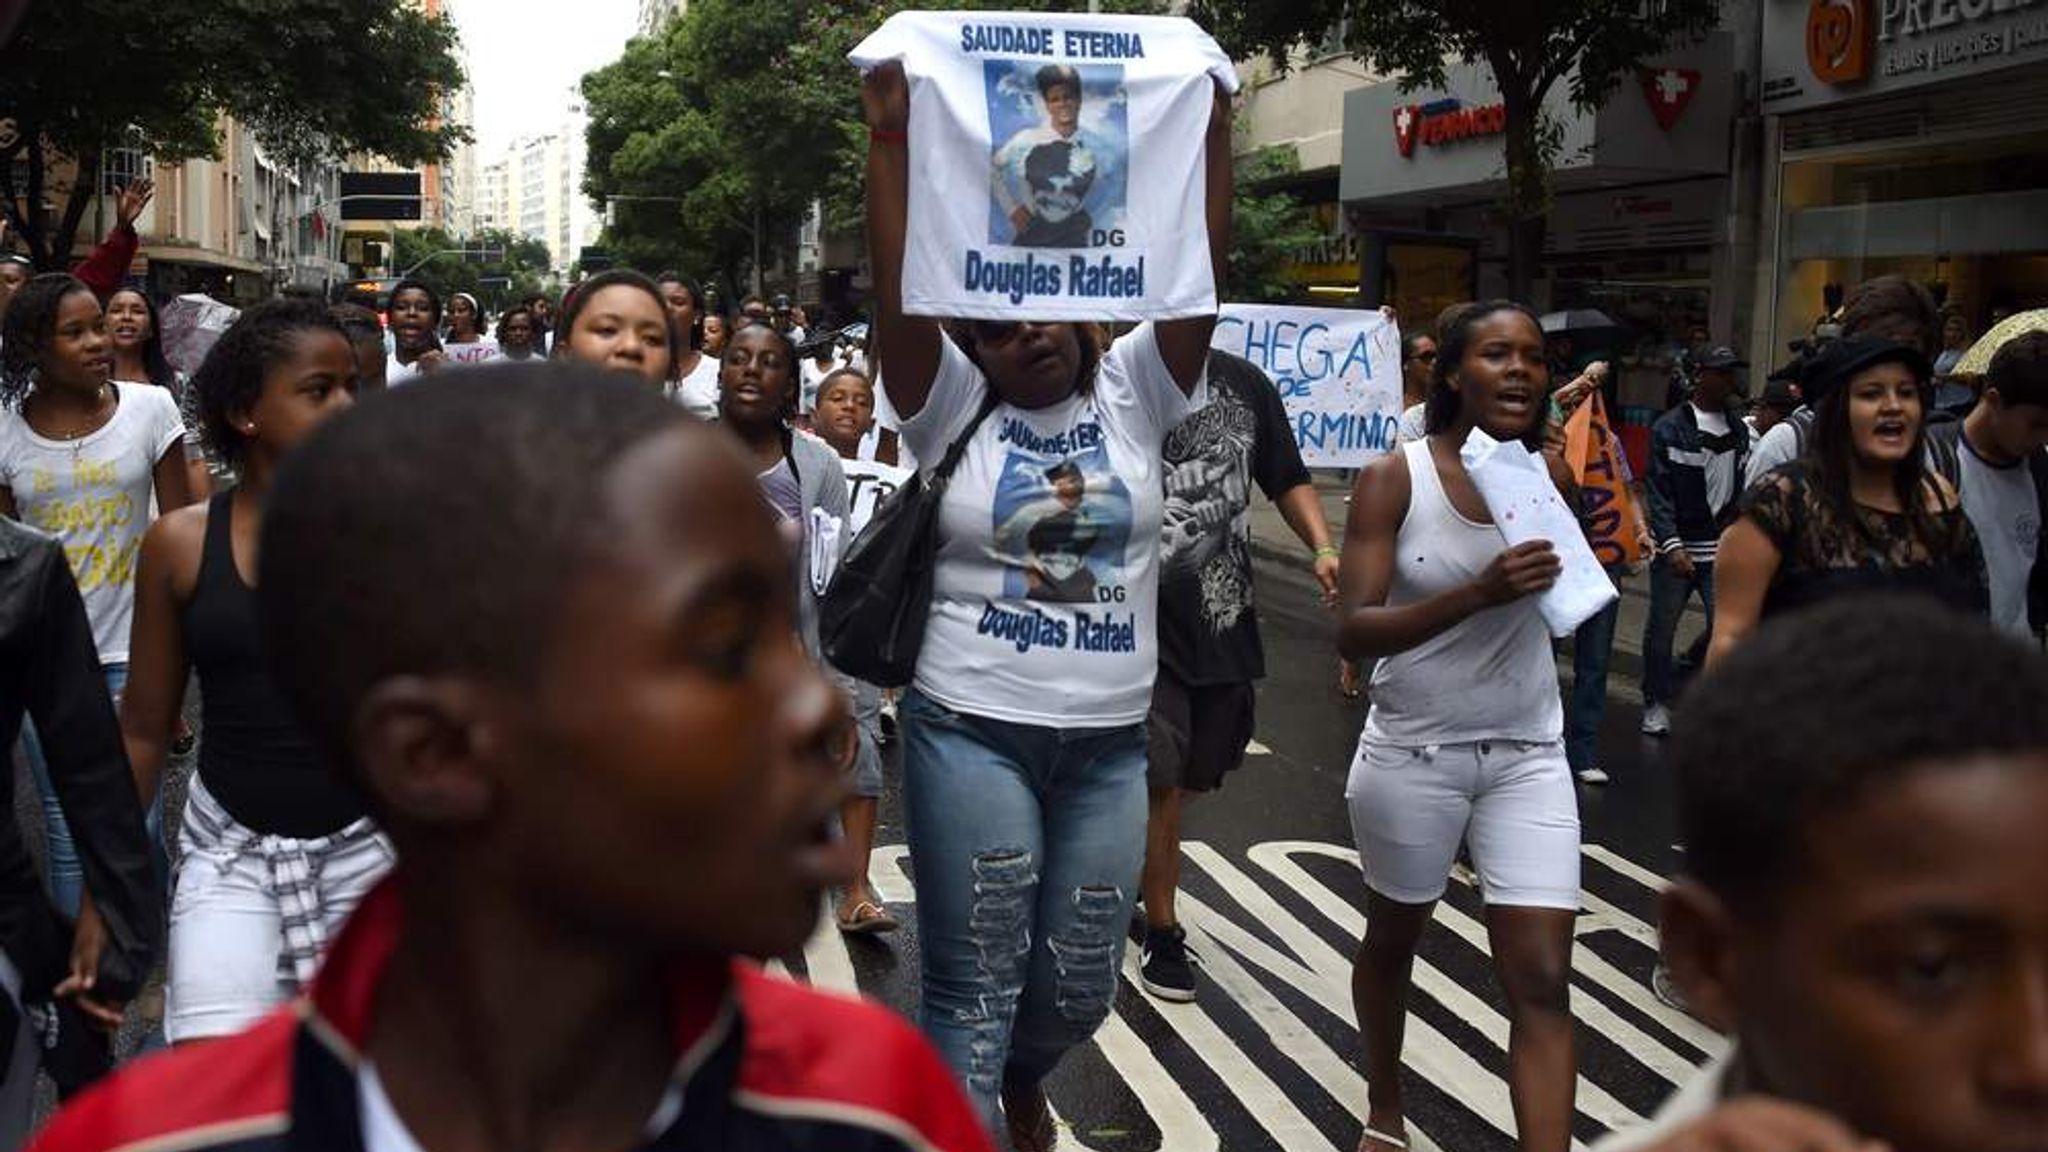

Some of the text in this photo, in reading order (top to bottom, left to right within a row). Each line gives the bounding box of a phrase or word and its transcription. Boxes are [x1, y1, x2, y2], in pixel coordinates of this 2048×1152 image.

[961, 25, 1146, 59] SAUDADE ETERNA
[1092, 229, 1126, 248] DG
[964, 249, 1145, 305] Douglas Rafael
[1277, 376, 1312, 397] DE
[1099, 585, 1127, 603] DG
[977, 601, 1136, 653] Douglas Rafael
